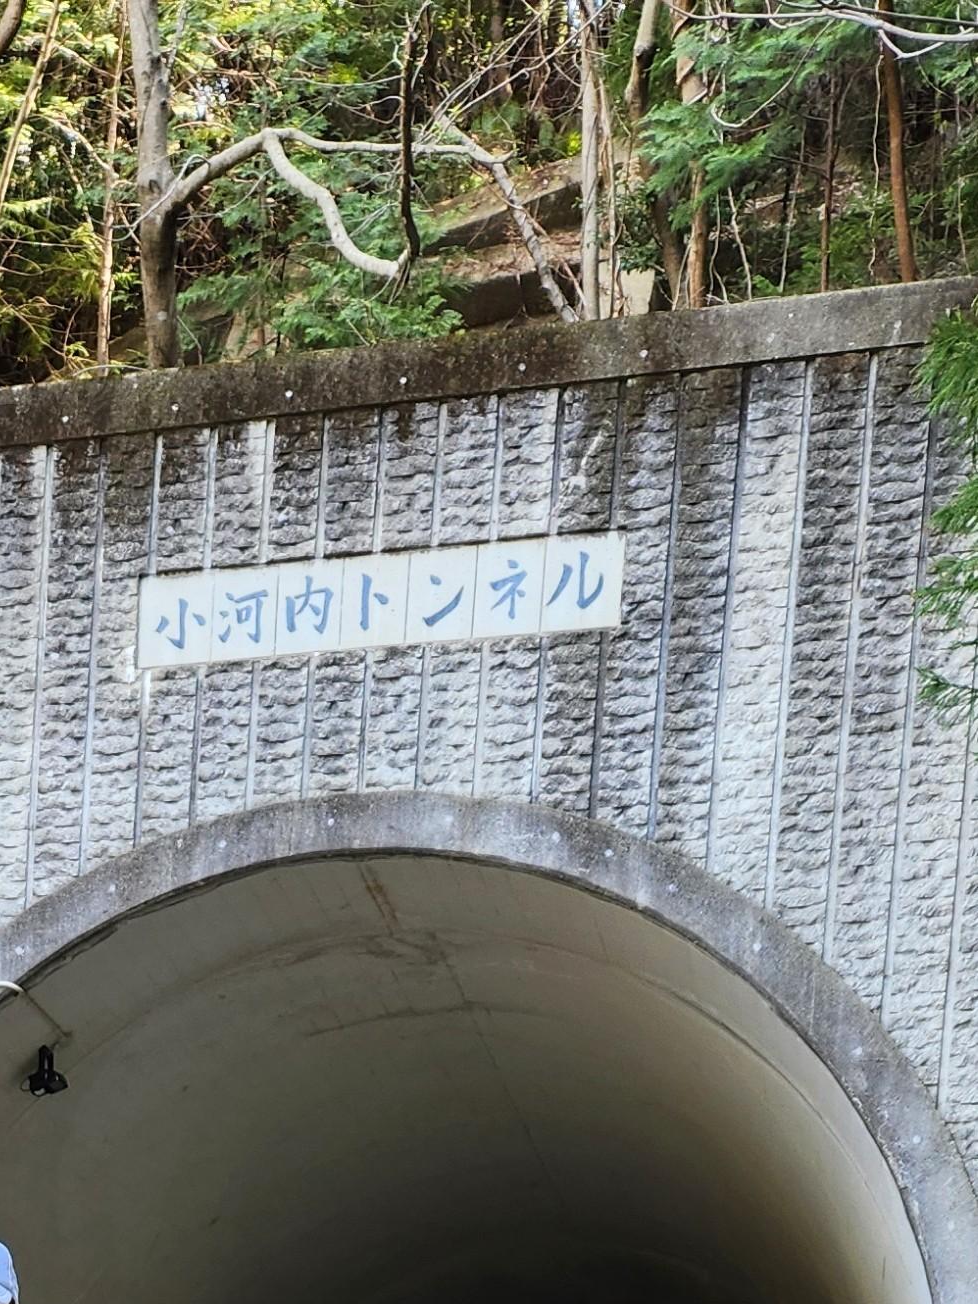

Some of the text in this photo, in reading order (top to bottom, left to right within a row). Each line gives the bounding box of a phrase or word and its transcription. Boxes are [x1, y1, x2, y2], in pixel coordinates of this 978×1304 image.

[154, 550, 605, 650] 小河内トンネル
